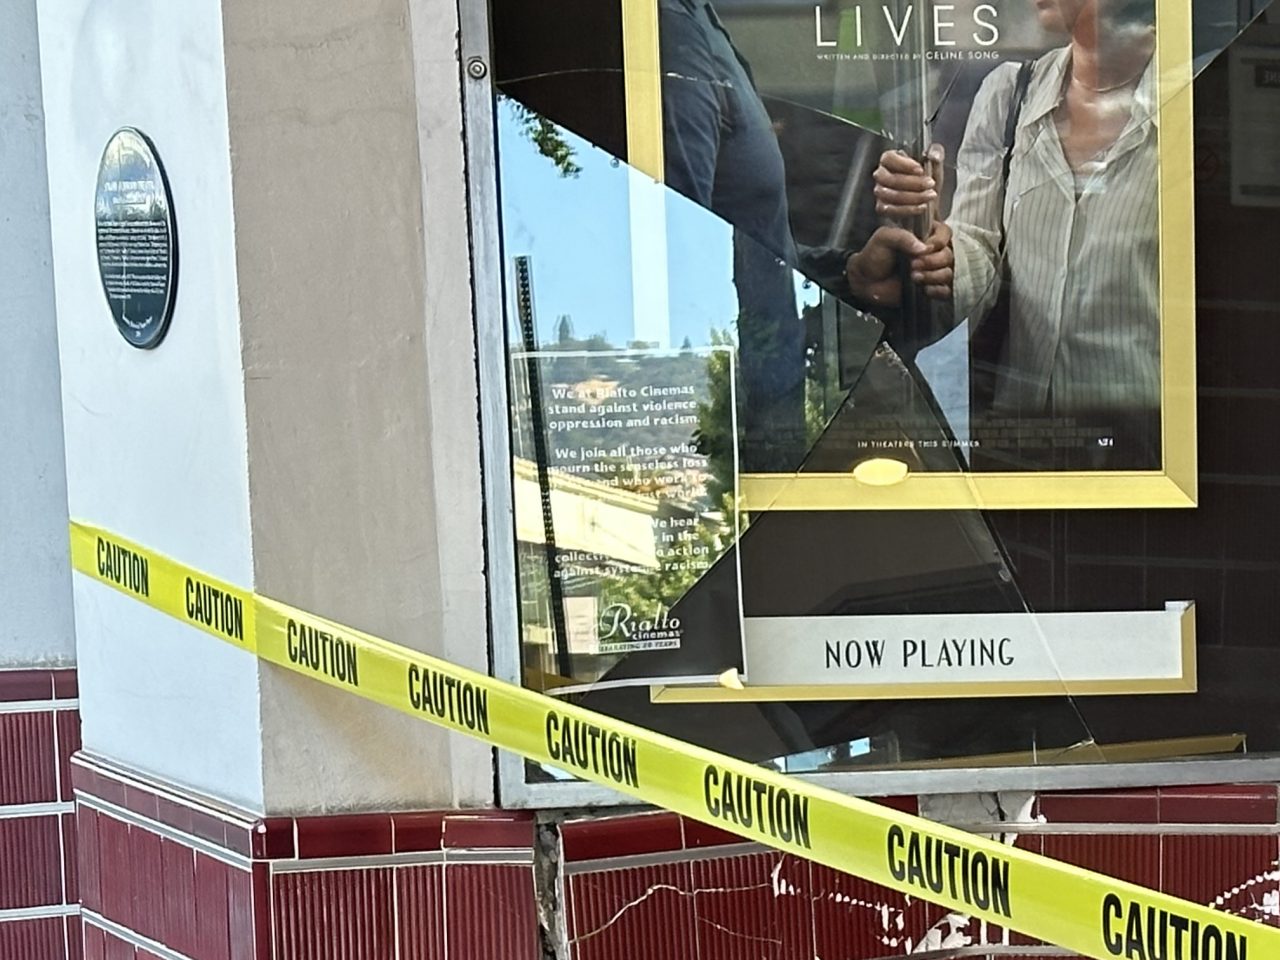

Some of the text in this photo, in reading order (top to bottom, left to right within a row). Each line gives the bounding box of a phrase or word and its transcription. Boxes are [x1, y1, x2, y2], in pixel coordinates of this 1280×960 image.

[815, 4, 999, 47] LIVES
[925, 51, 963, 60] CELINE
[968, 51, 1000, 60] SONG
[548, 403, 586, 415] stand
[589, 402, 638, 416] against
[552, 388, 574, 400] We
[640, 384, 695, 397] Cinemas
[549, 414, 700, 432] oppression and racism.
[555, 443, 697, 461] We join all those who
[594, 462, 616, 473] the
[96, 536, 150, 598] CAUTION
[185, 577, 244, 641] CAUTION
[594, 602, 680, 639] Rialto
[287, 618, 358, 687] CAUTION
[632, 630, 681, 641] cinemas
[825, 637, 1014, 669] NOW PLAYING
[408, 662, 489, 736] CAUTION
[546, 711, 639, 789] CAUTION
[704, 764, 811, 850] CAUTION
[887, 824, 1012, 919] CAUTION
